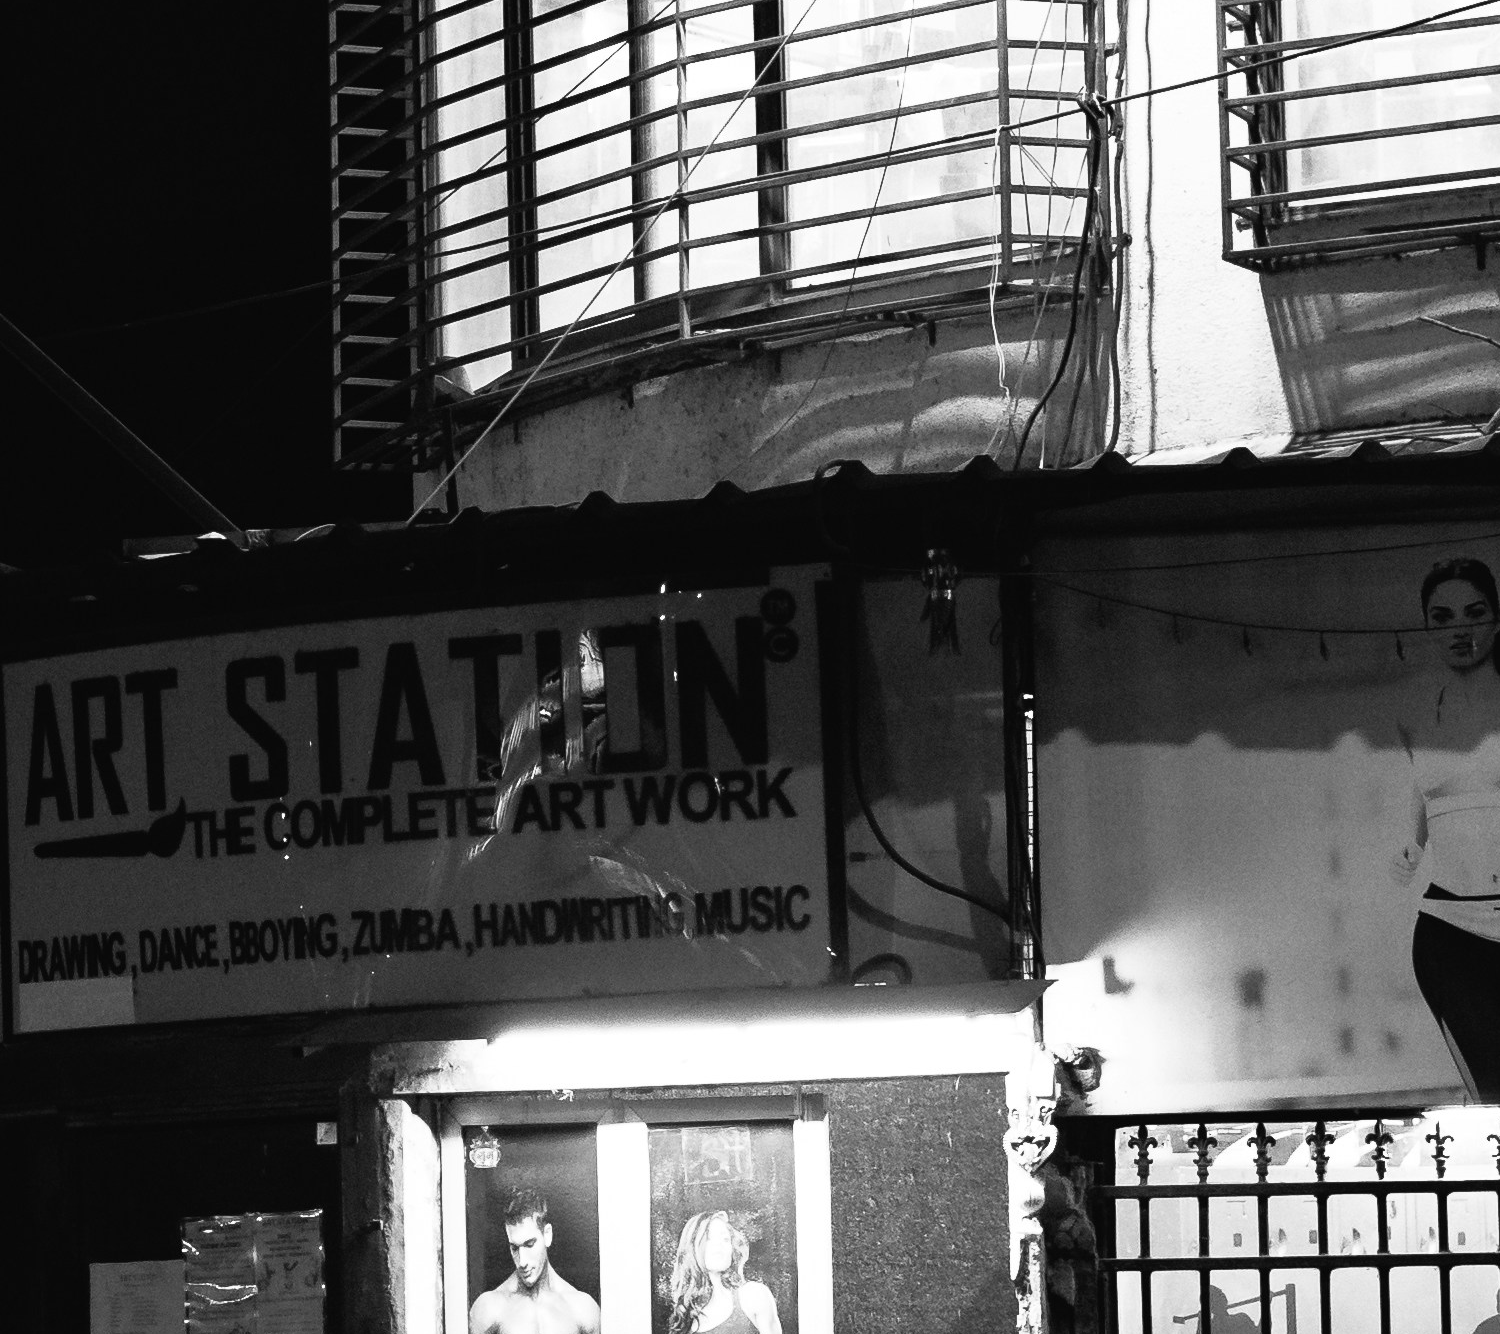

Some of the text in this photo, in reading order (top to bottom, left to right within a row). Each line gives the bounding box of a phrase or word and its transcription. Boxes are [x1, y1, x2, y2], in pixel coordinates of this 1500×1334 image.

[24, 615, 769, 827] ART STATION
[186, 767, 798, 859] THE COMPLETE ART WORK
[696, 884, 812, 936] MUSIC
